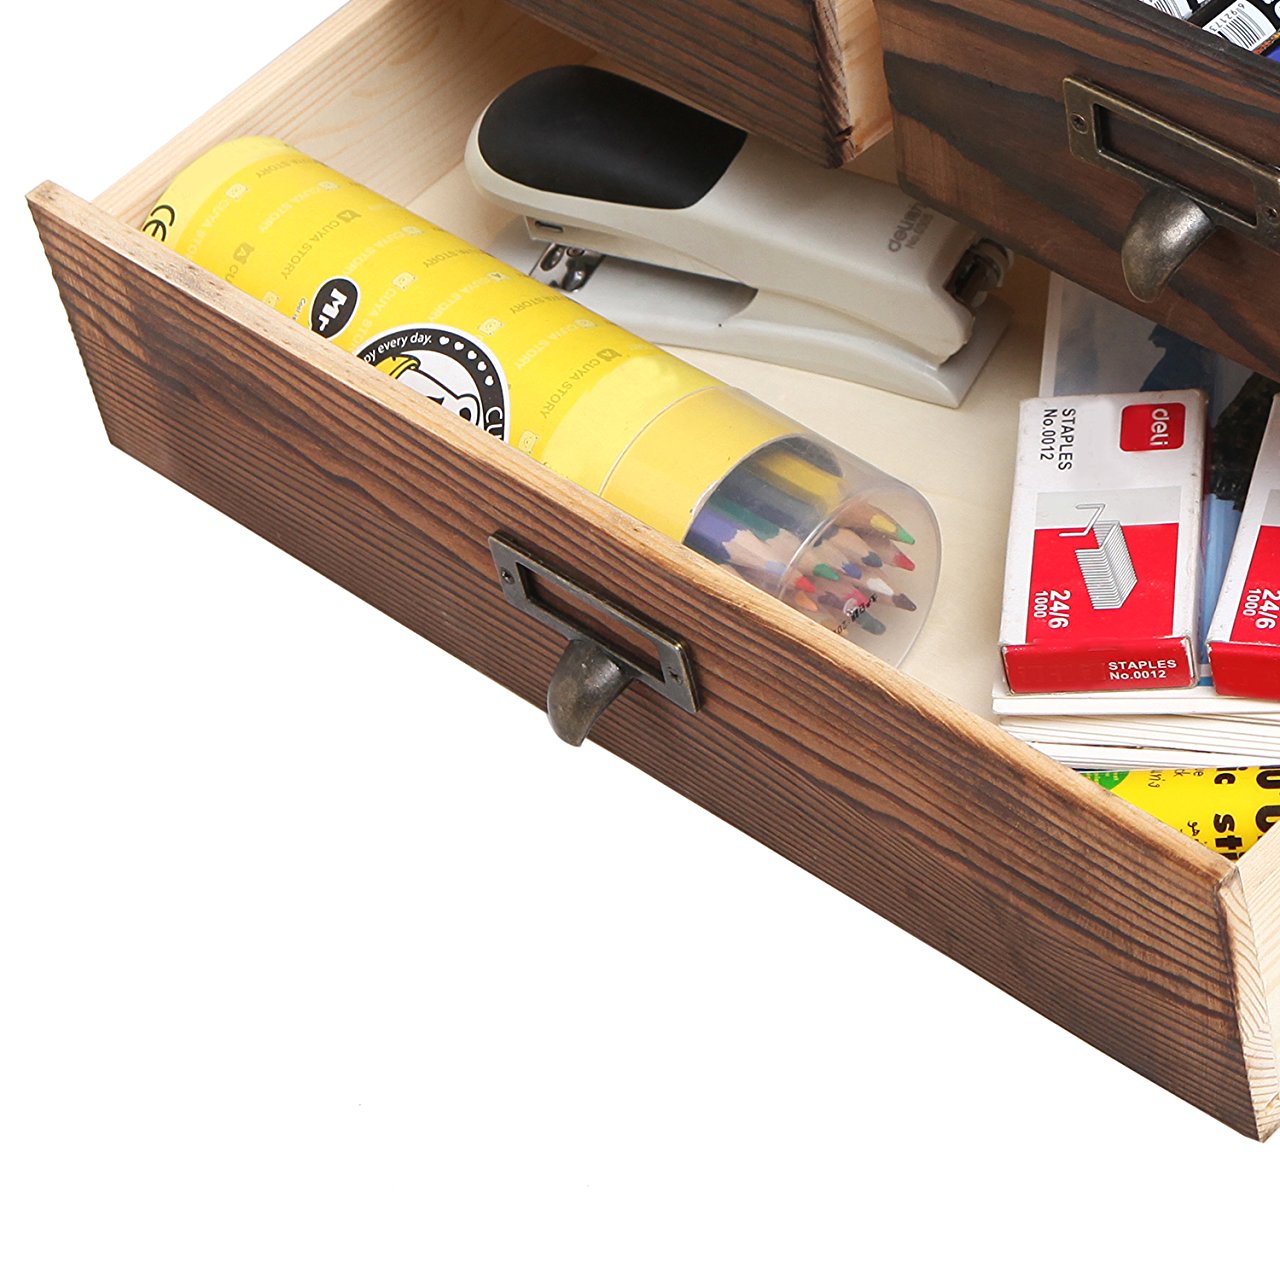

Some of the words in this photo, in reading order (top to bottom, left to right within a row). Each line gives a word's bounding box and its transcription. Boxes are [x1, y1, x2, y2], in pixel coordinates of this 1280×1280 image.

[309, 219, 340, 243] CUYA
[281, 242, 312, 279] STORY
[378, 337, 408, 354] every
[410, 332, 432, 345] day.
[572, 359, 600, 382] CUYA
[539, 380, 574, 420] STORY
[1039, 407, 1058, 461] No.0012
[1058, 407, 1076, 470] STAPLES
[1149, 407, 1168, 448] deli
[1032, 589, 1048, 618] 1000
[1049, 588, 1071, 629] 24/6
[1242, 588, 1260, 617] 1000
[1107, 658, 1177, 671] STAPLES
[1109, 669, 1167, 681] No.0012
